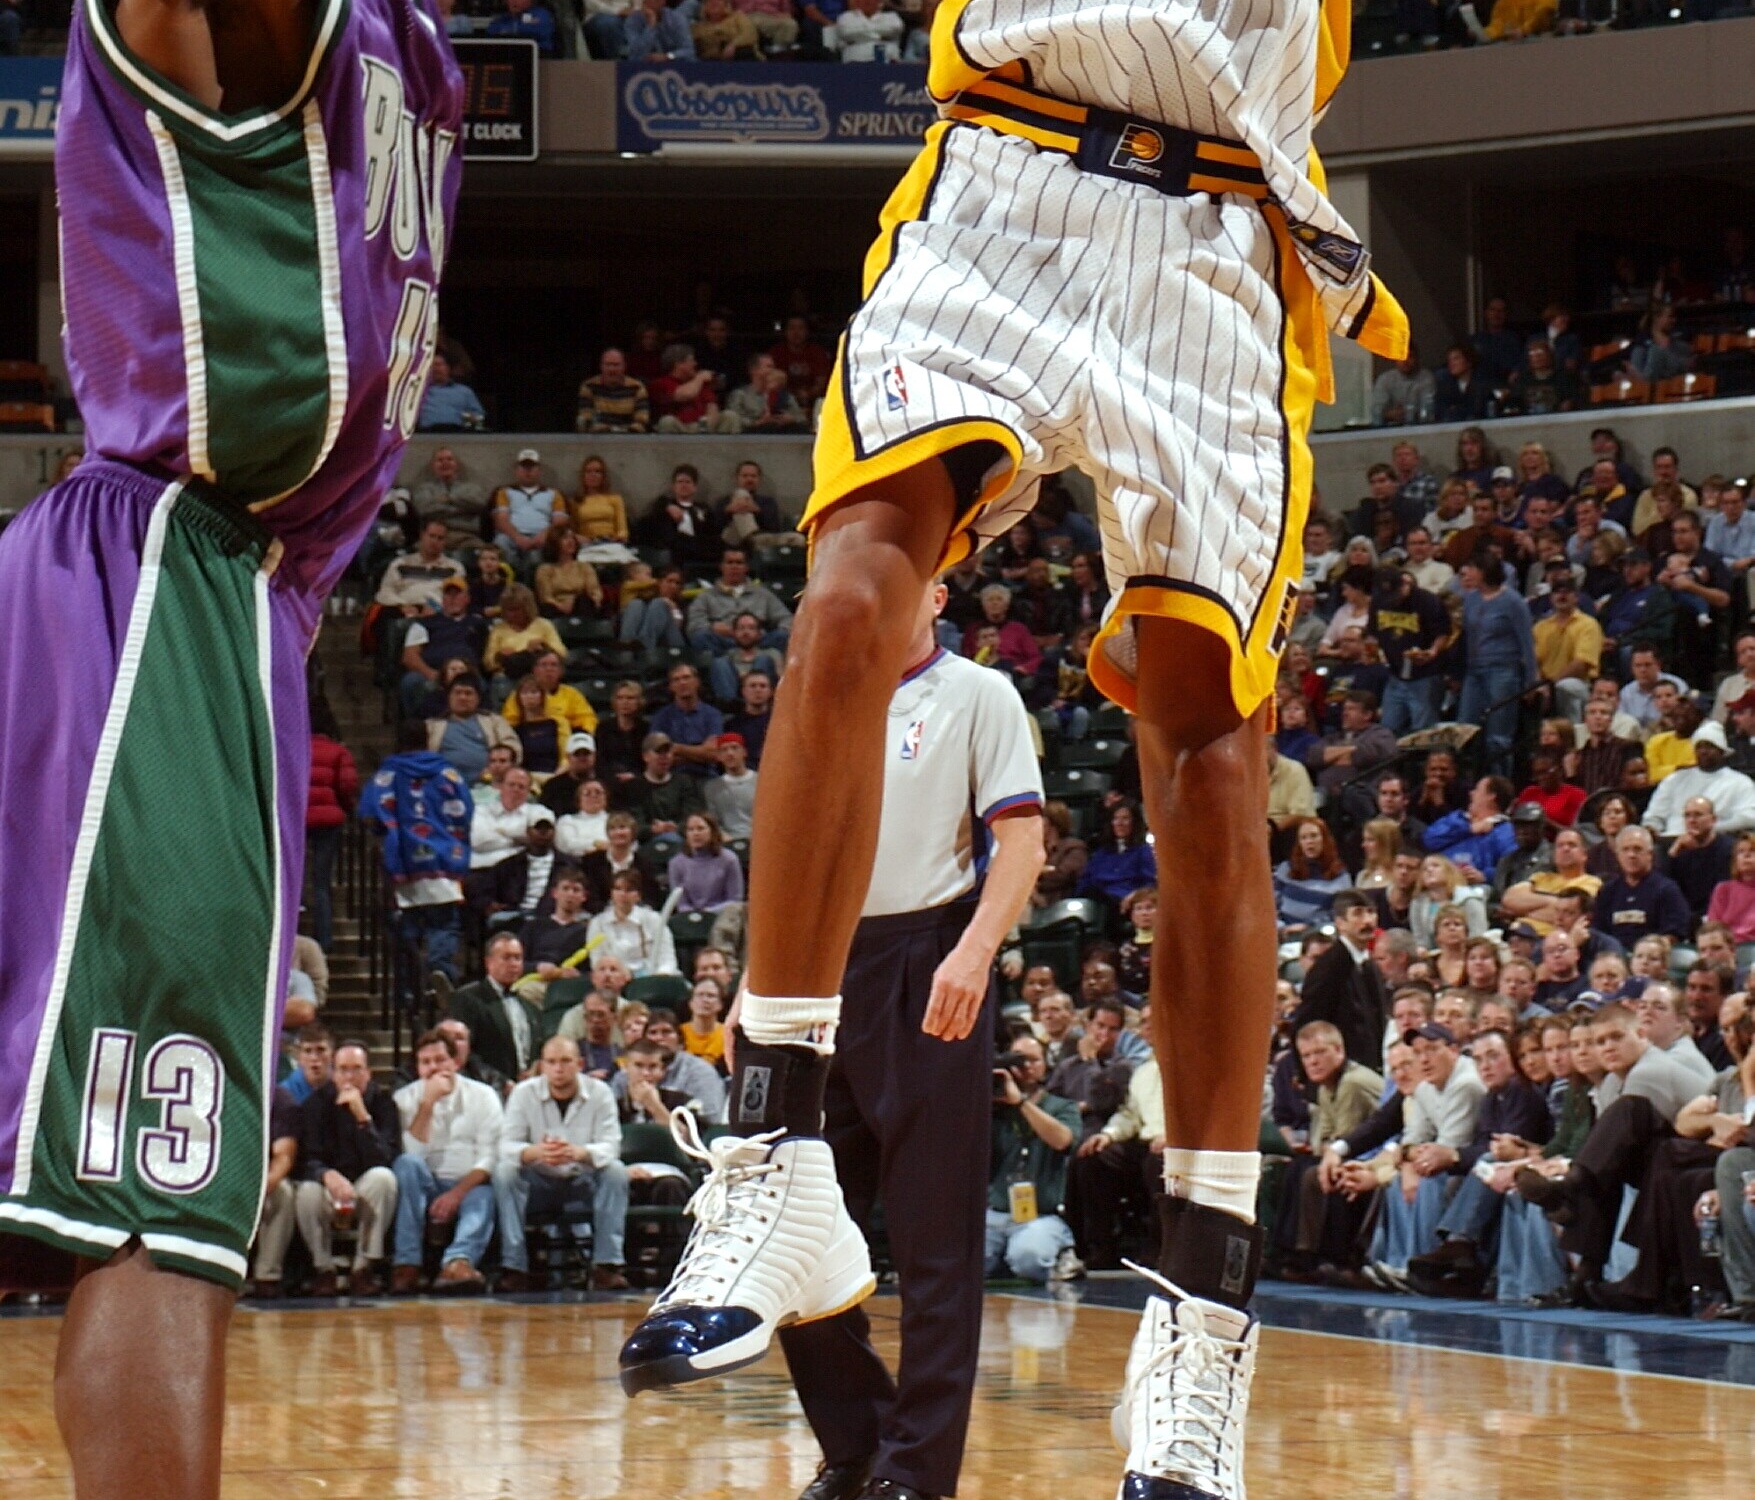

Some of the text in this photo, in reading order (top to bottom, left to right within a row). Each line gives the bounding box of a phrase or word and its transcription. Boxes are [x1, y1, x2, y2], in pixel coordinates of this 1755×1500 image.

[473, 122, 522, 140] CLOCK
[838, 111, 925, 137] SPRING
[76, 1026, 226, 1195] 13
